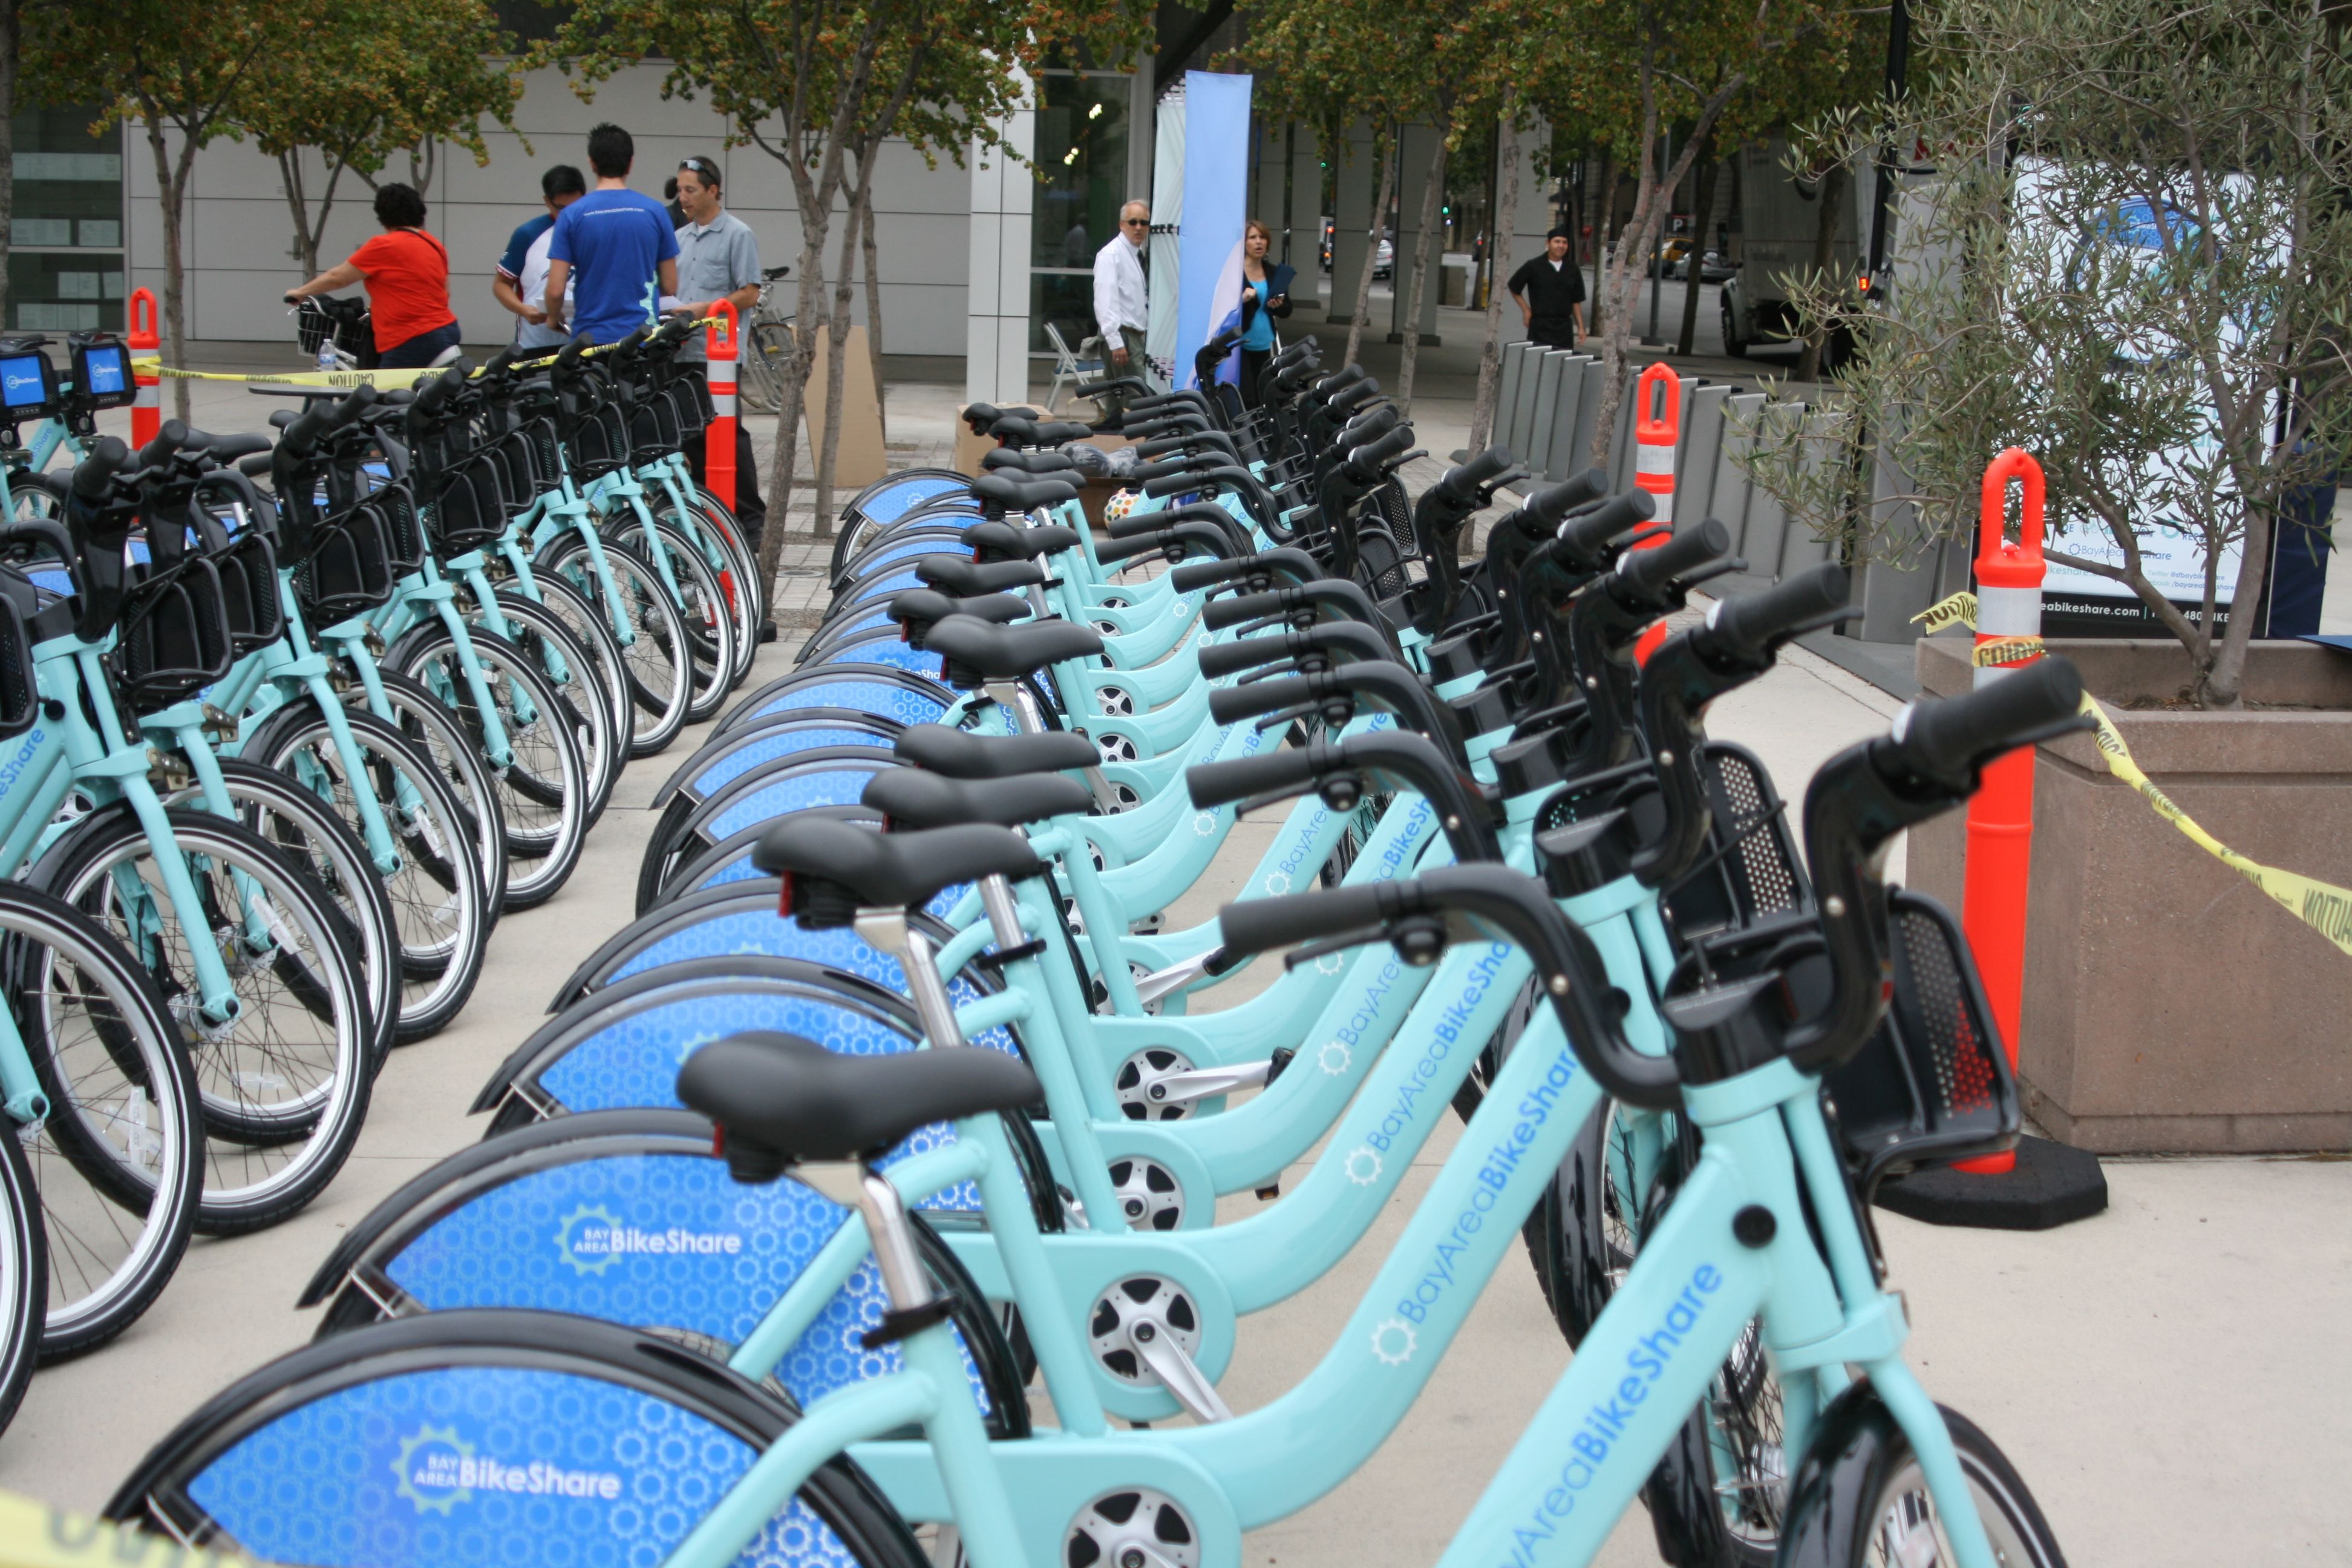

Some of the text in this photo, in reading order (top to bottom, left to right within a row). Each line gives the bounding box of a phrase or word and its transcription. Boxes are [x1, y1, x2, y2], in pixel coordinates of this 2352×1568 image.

[2040, 602, 2140, 618] eabikeshare.com
[1397, 1042, 1578, 1325] BayAreaBikeShar
[573, 1227, 741, 1255] AREA BikeShare
[584, 1228, 609, 1240] BAY
[428, 1455, 457, 1471] BAY
[414, 1457, 622, 1500] AREA BikeShare
